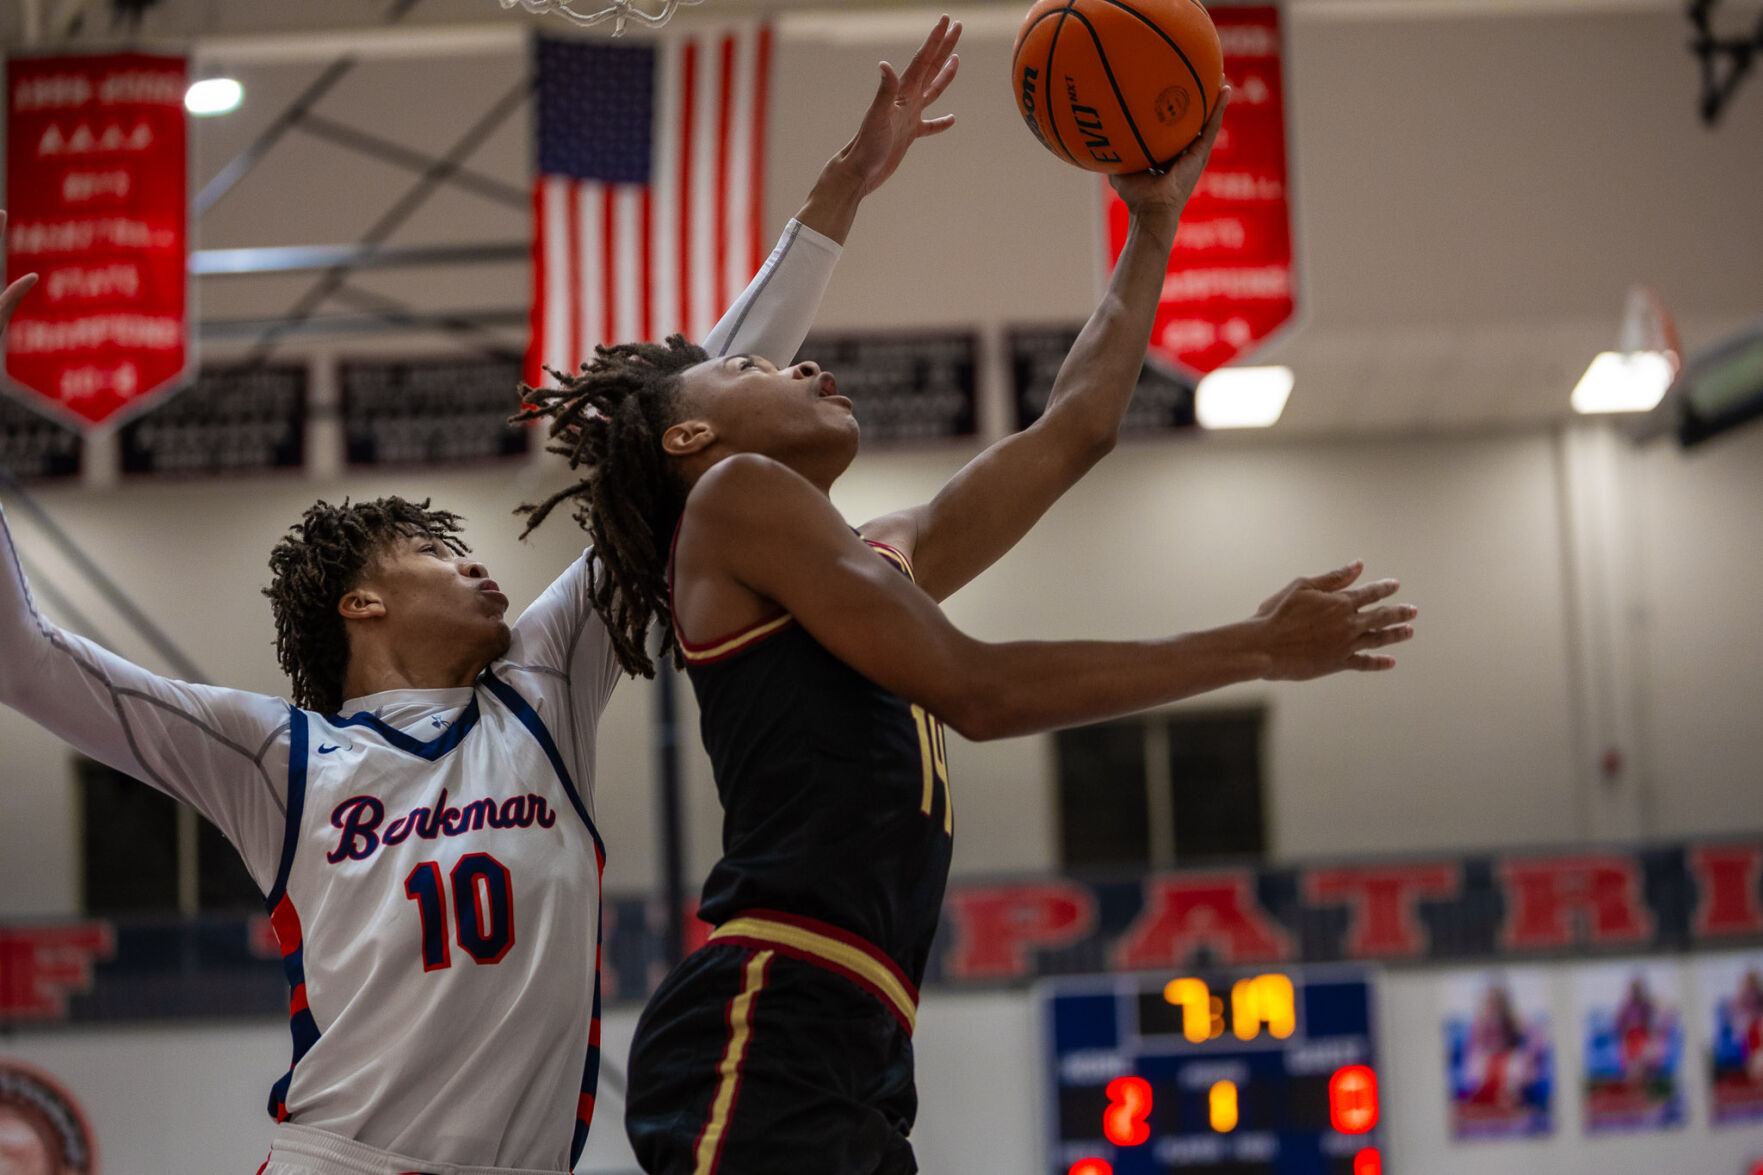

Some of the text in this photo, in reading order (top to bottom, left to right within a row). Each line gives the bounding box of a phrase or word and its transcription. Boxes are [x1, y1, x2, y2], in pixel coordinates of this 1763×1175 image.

[1065, 74, 1078, 102] NXT
[326, 787, 556, 865] Berkmar
[404, 852, 516, 973] 10
